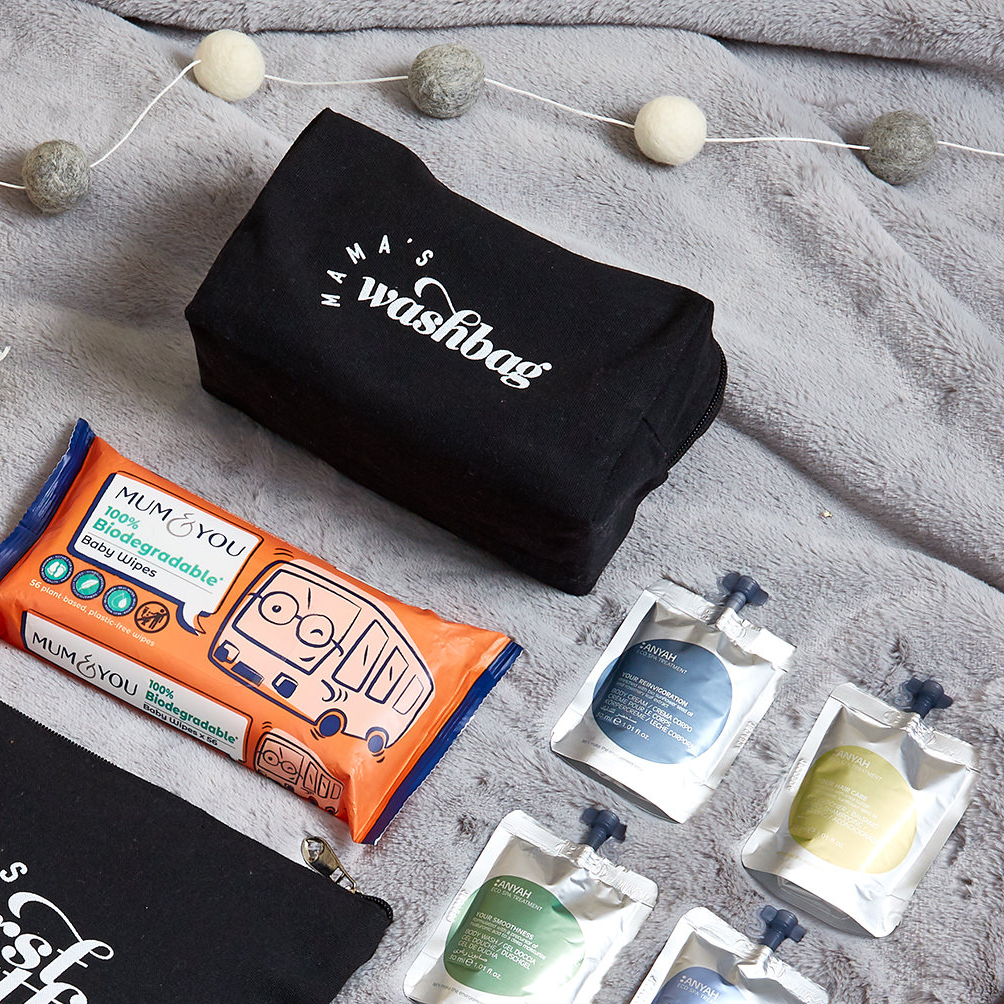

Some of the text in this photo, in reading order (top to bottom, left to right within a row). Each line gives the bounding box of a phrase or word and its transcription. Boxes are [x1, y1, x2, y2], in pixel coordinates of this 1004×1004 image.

[320, 234, 434, 308] MAMA'S
[357, 276, 553, 390] washbag
[104, 505, 140, 530] 100%
[81, 534, 158, 579] Baby Wipes
[29, 578, 41, 589] 56
[40, 585, 87, 613] plant-based,
[87, 607, 132, 635] plastic-free
[131, 628, 155, 647] wipes
[657, 658, 686, 674] TREATMENT
[149, 679, 174, 699] 100%
[621, 671, 688, 706] YOUR REINVIGORATION
[143, 704, 218, 746] Baby Wipes 56
[621, 722, 633, 731] 1.01
[627, 694, 647, 707] CREAM
[651, 706, 672, 719] CREMA
[672, 717, 692, 732] CORPO
[627, 702, 643, 712] POUR
[651, 713, 670, 726] CORPS
[649, 719, 667, 732] LECHE
[491, 886, 501, 894] ECO
[512, 894, 542, 911] TREATMENT
[476, 910, 491, 921] YOUR
[492, 917, 533, 939] SMOOTHNESS
[465, 928, 479, 938] BODY
[481, 933, 497, 944] WASH
[502, 943, 513, 951] GEL
[513, 949, 536, 964] DOCCIA
[472, 937, 495, 951] DOUCHE
[500, 950, 531, 969] DUSCHGEL
[477, 946, 498, 959] DUCHA
[473, 962, 485, 971] 1.01
